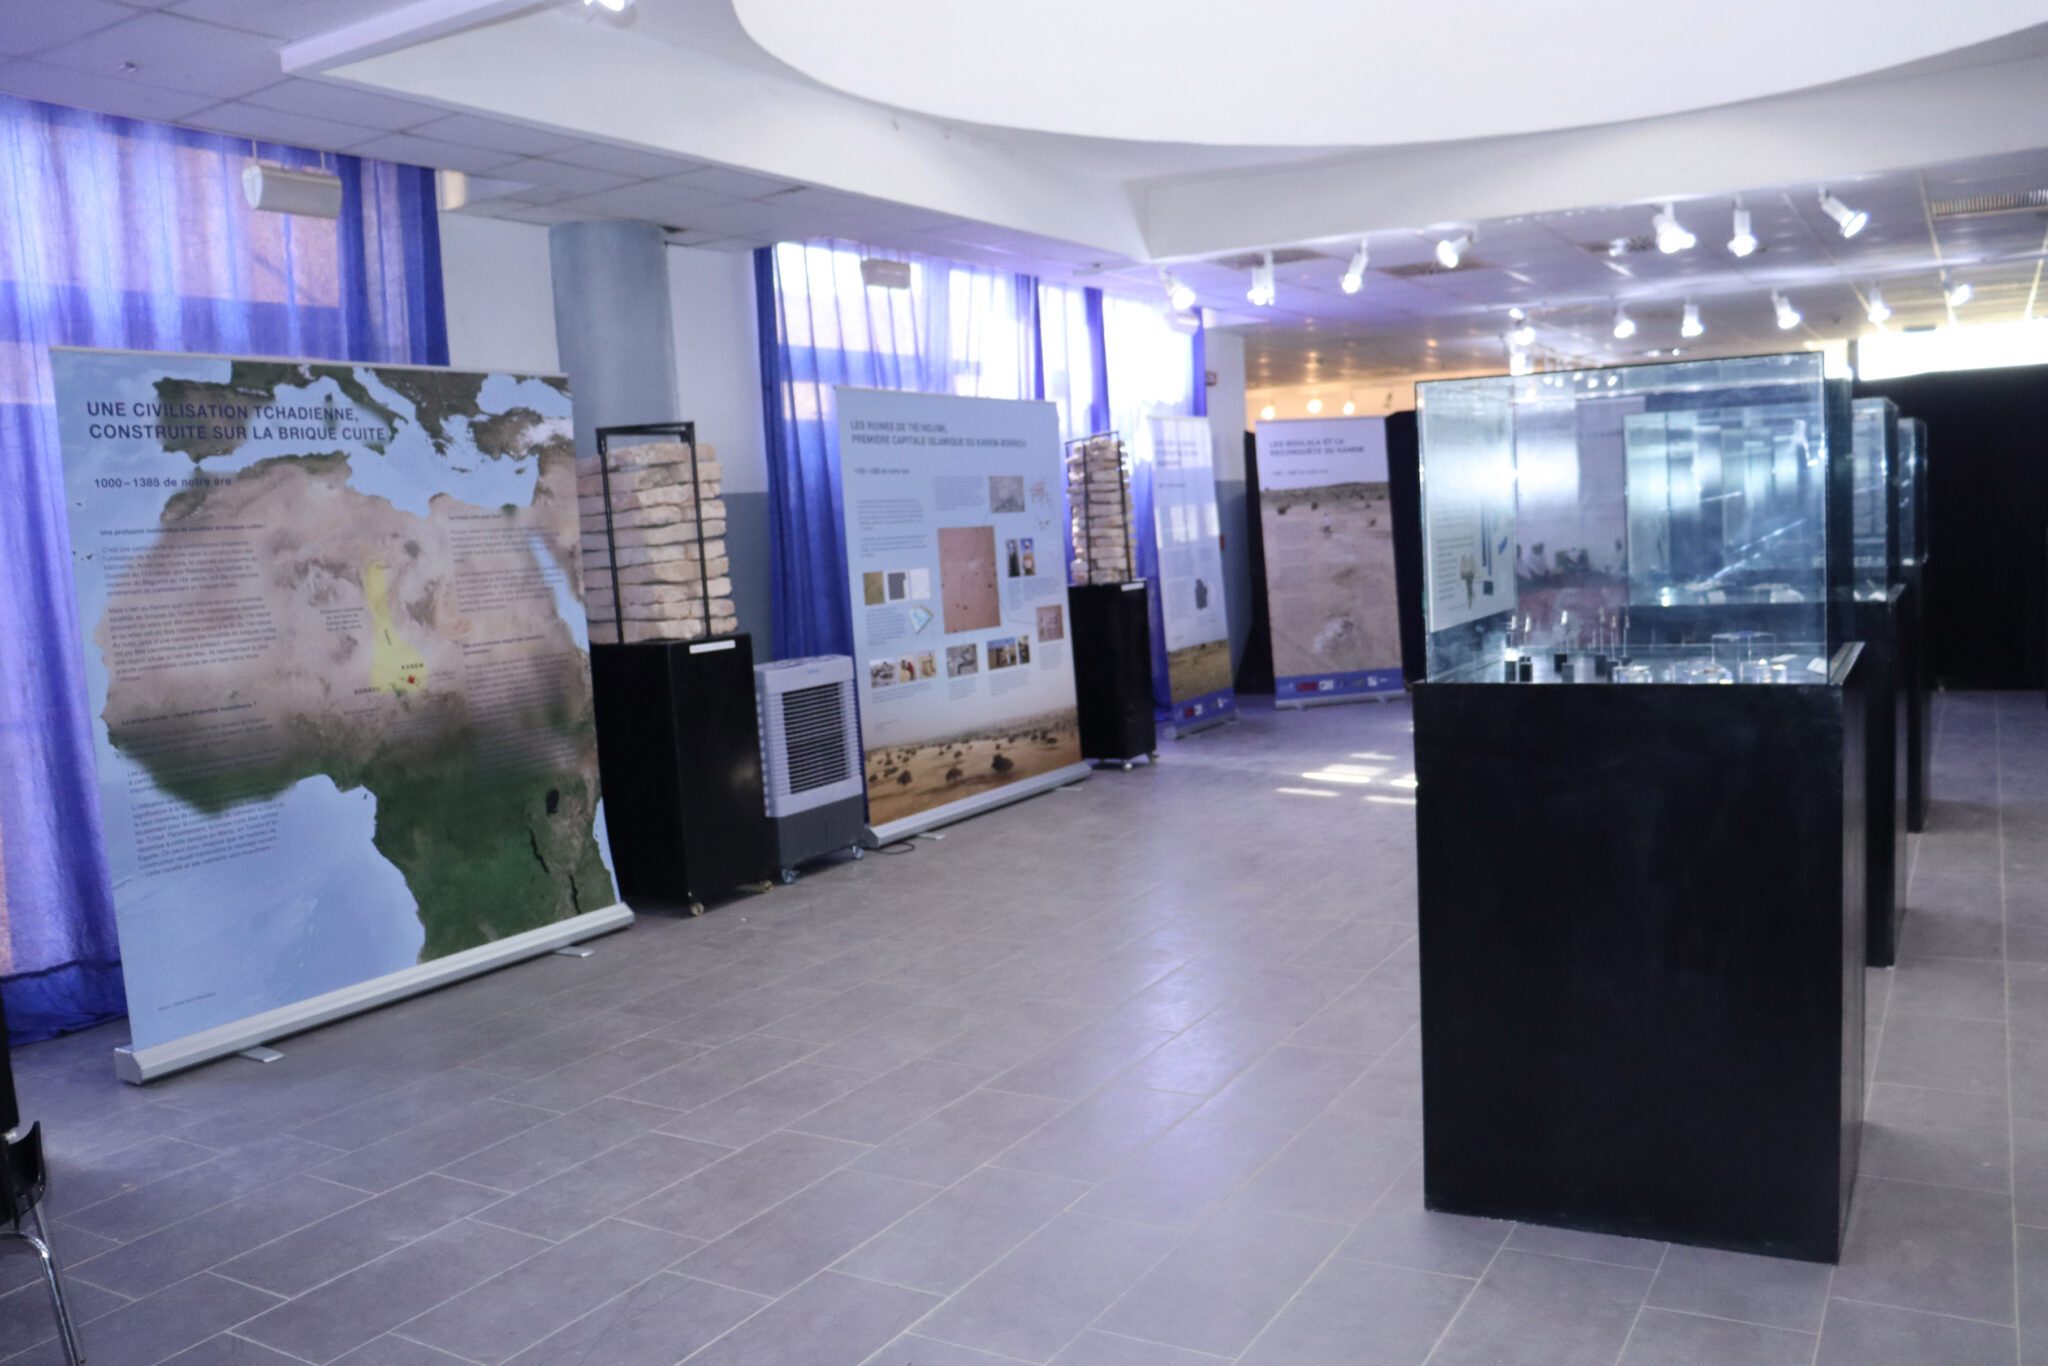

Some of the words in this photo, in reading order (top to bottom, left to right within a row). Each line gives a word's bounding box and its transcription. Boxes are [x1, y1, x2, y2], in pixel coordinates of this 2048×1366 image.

[87, 401, 126, 417] UNE
[133, 403, 248, 419] CIVILISATION
[253, 406, 359, 422] TCHADIENNE,
[850, 420, 865, 431] LES
[867, 421, 894, 432] RUINES
[896, 422, 905, 432] DE
[89, 424, 207, 440] CONSTRUITE
[213, 425, 247, 440] SUR
[252, 426, 274, 440] LA
[278, 426, 337, 442] BRIQUE
[342, 427, 386, 441] CUITE
[892, 435, 926, 446] CAPITALE
[928, 436, 964, 447] ISLAMIQUE
[164, 477, 178, 488] de
[181, 477, 210, 488] notre
[214, 477, 232, 487] ère
